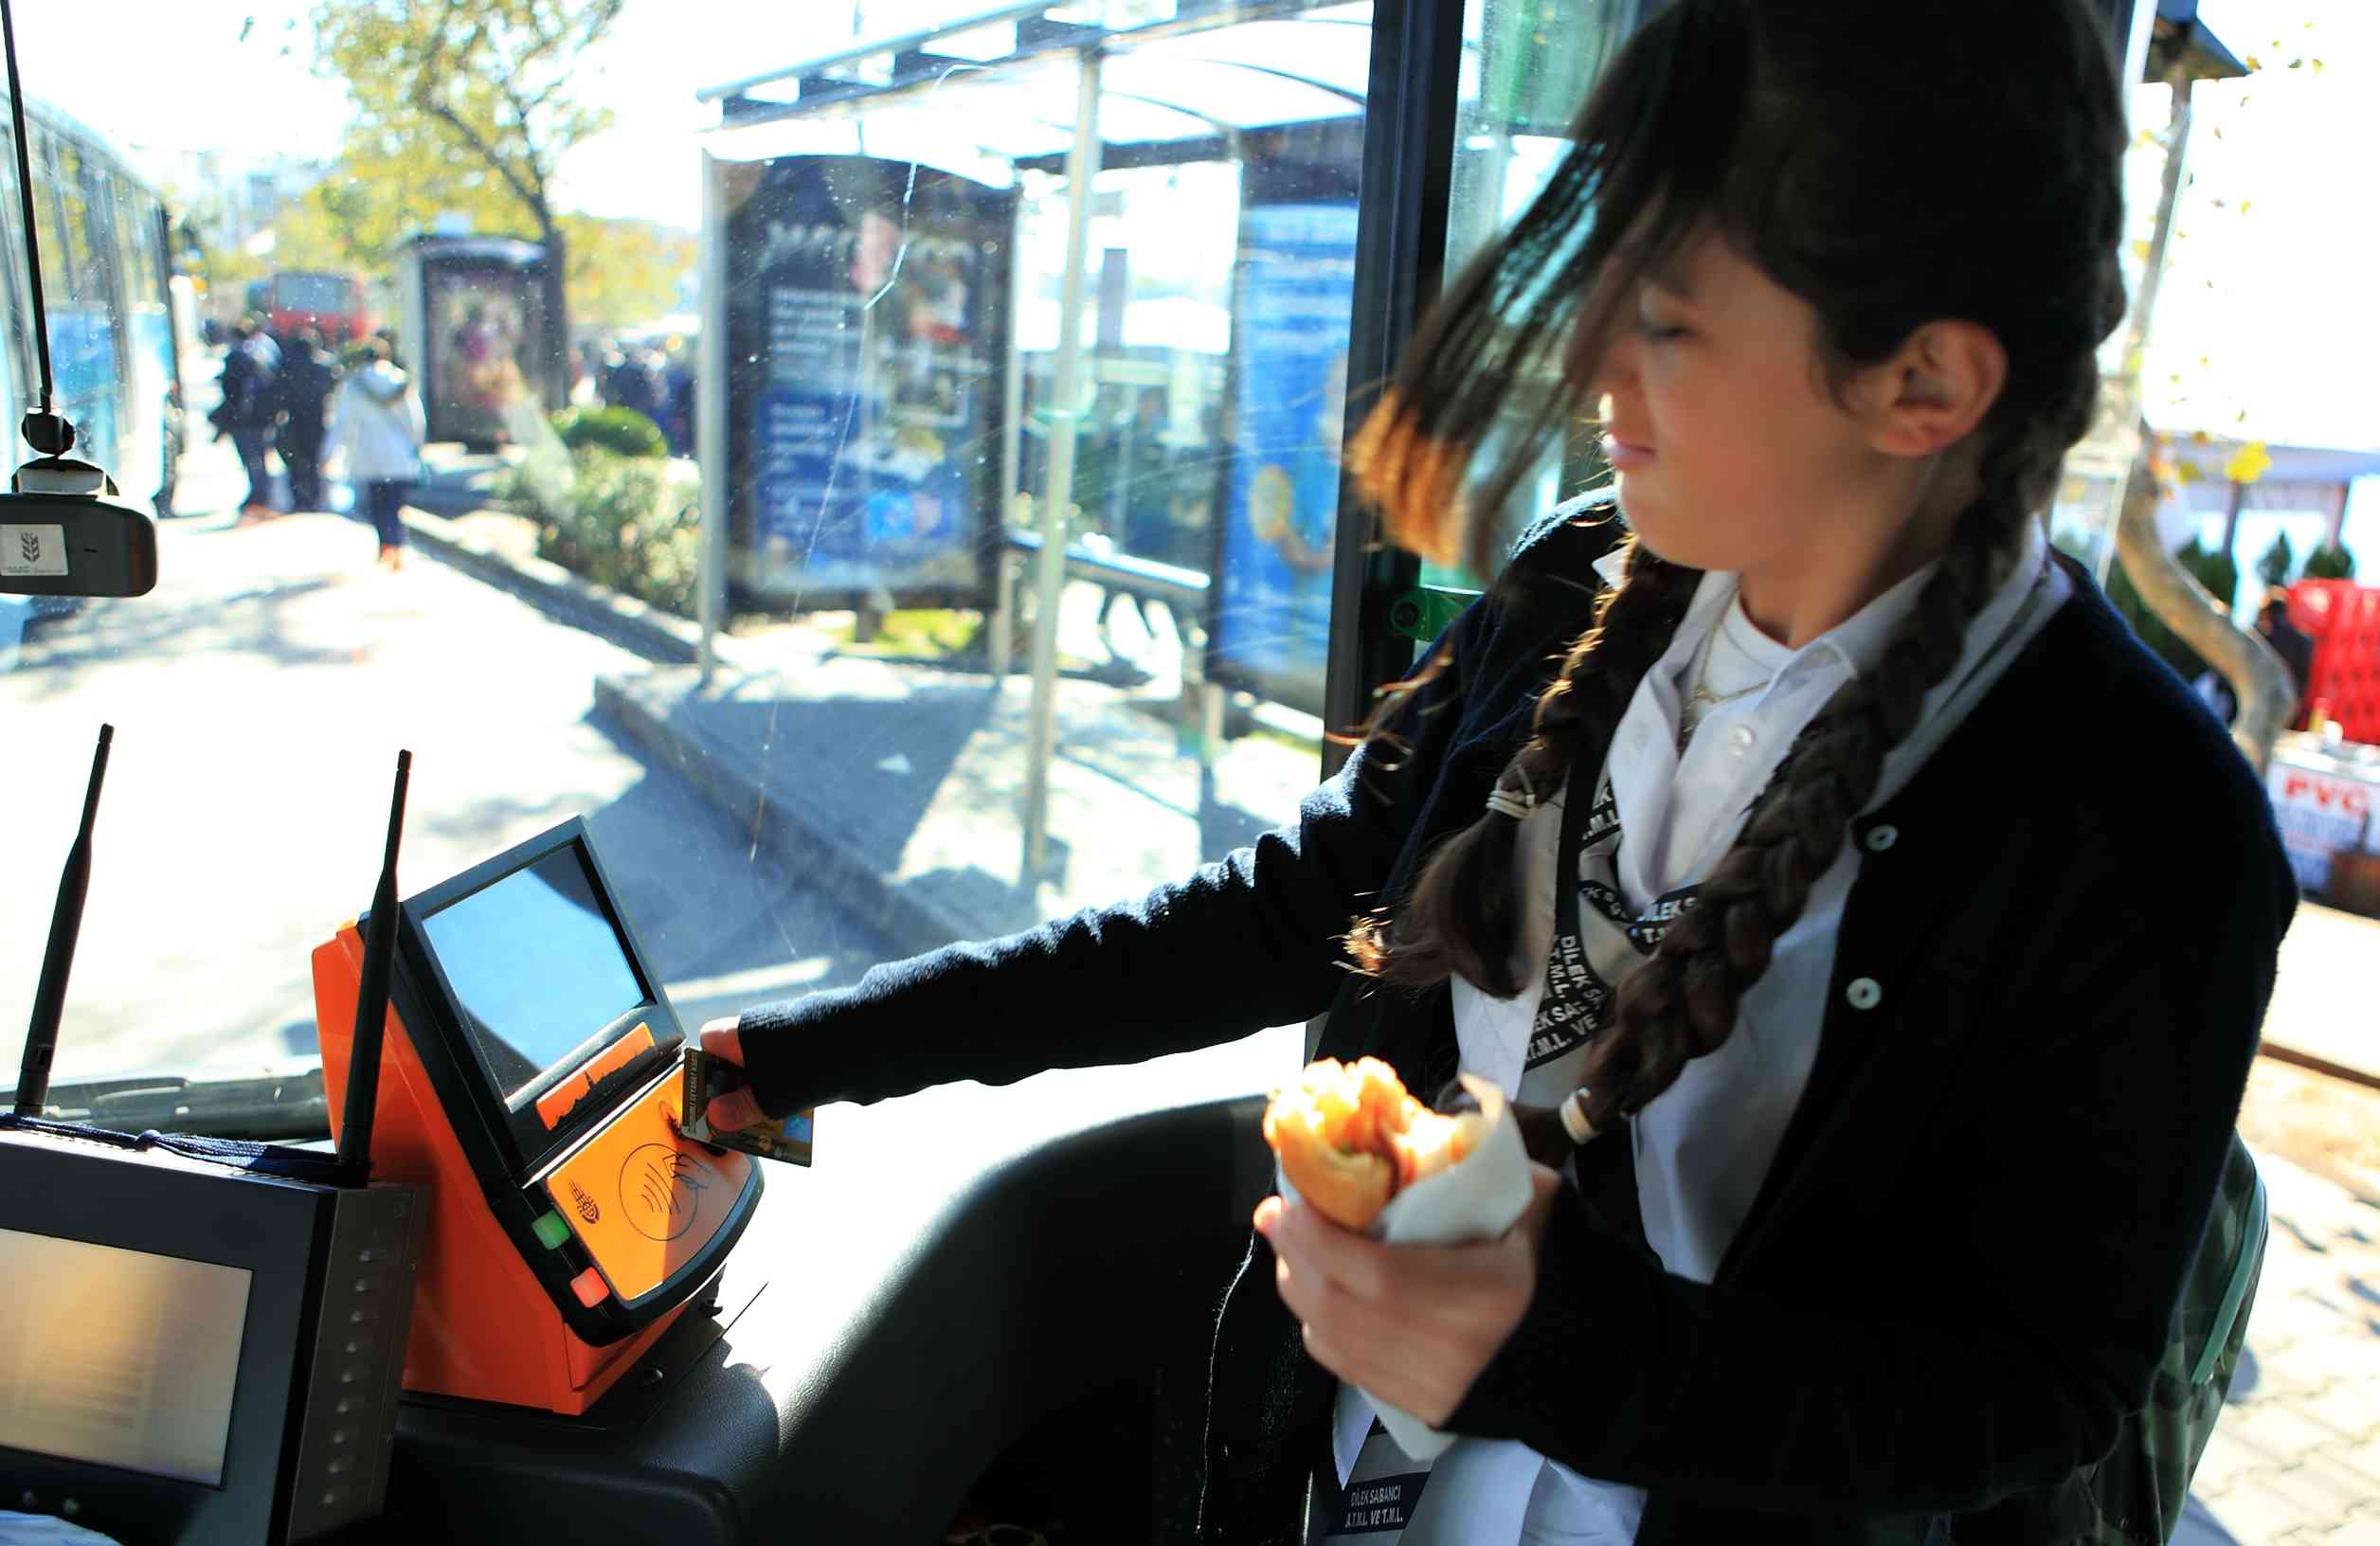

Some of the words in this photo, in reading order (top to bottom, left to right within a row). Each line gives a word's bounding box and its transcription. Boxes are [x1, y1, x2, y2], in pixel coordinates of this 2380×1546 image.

[1569, 1013, 1598, 1035] VE
[1369, 1484, 1401, 1504] SABANCI
[1370, 1509, 1381, 1526] VE
